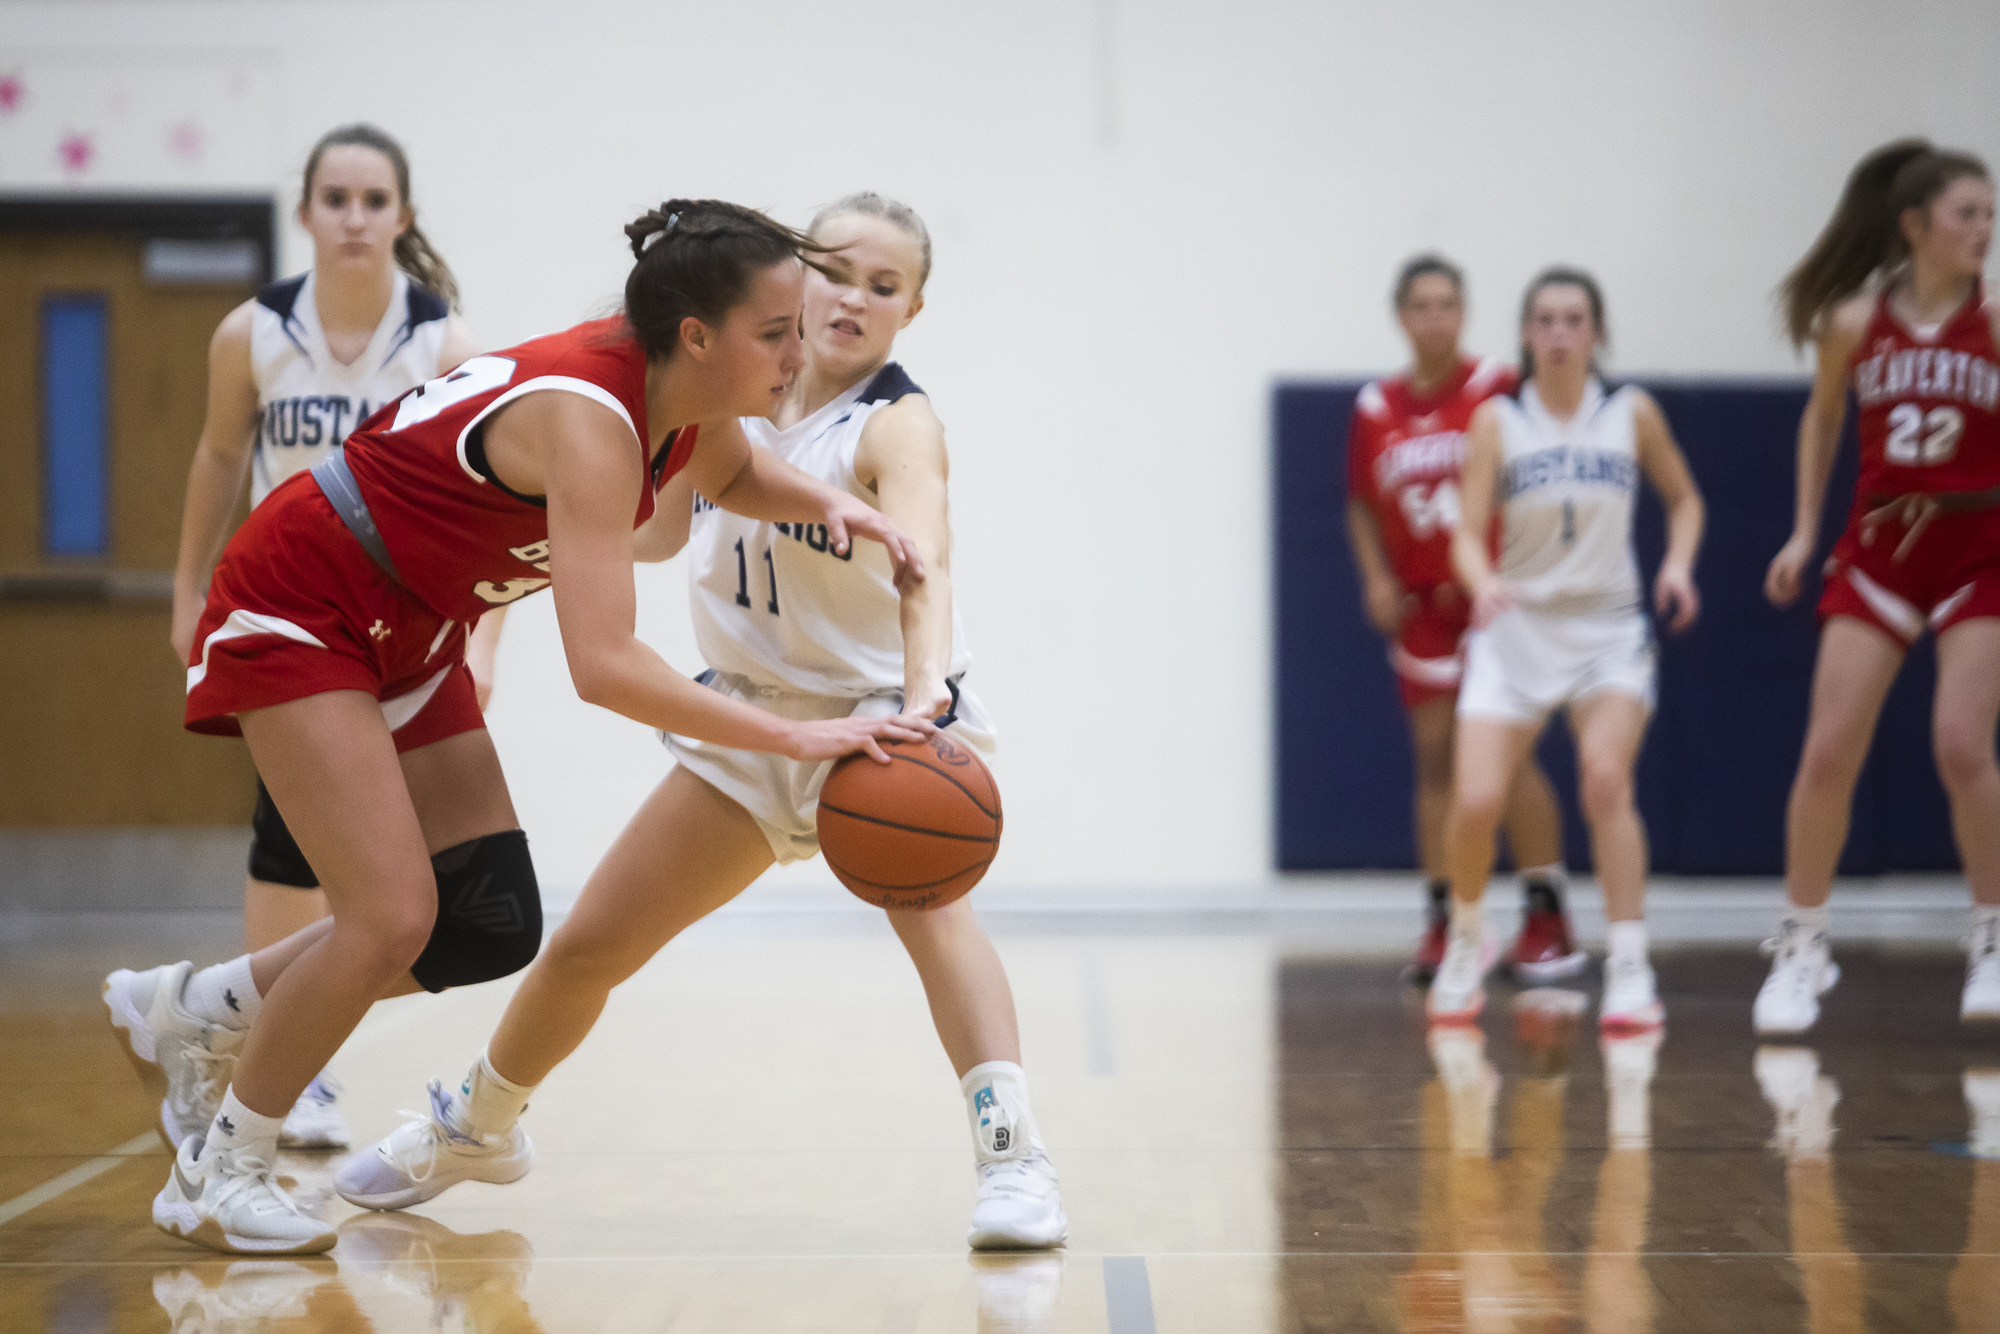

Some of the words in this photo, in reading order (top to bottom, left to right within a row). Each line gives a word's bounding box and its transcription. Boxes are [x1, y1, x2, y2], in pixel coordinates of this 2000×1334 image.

[1855, 347, 2000, 413] BEAVERTON
[1884, 402, 1964, 466] 22
[1561, 496, 1576, 542] 1
[734, 536, 780, 617] 11
